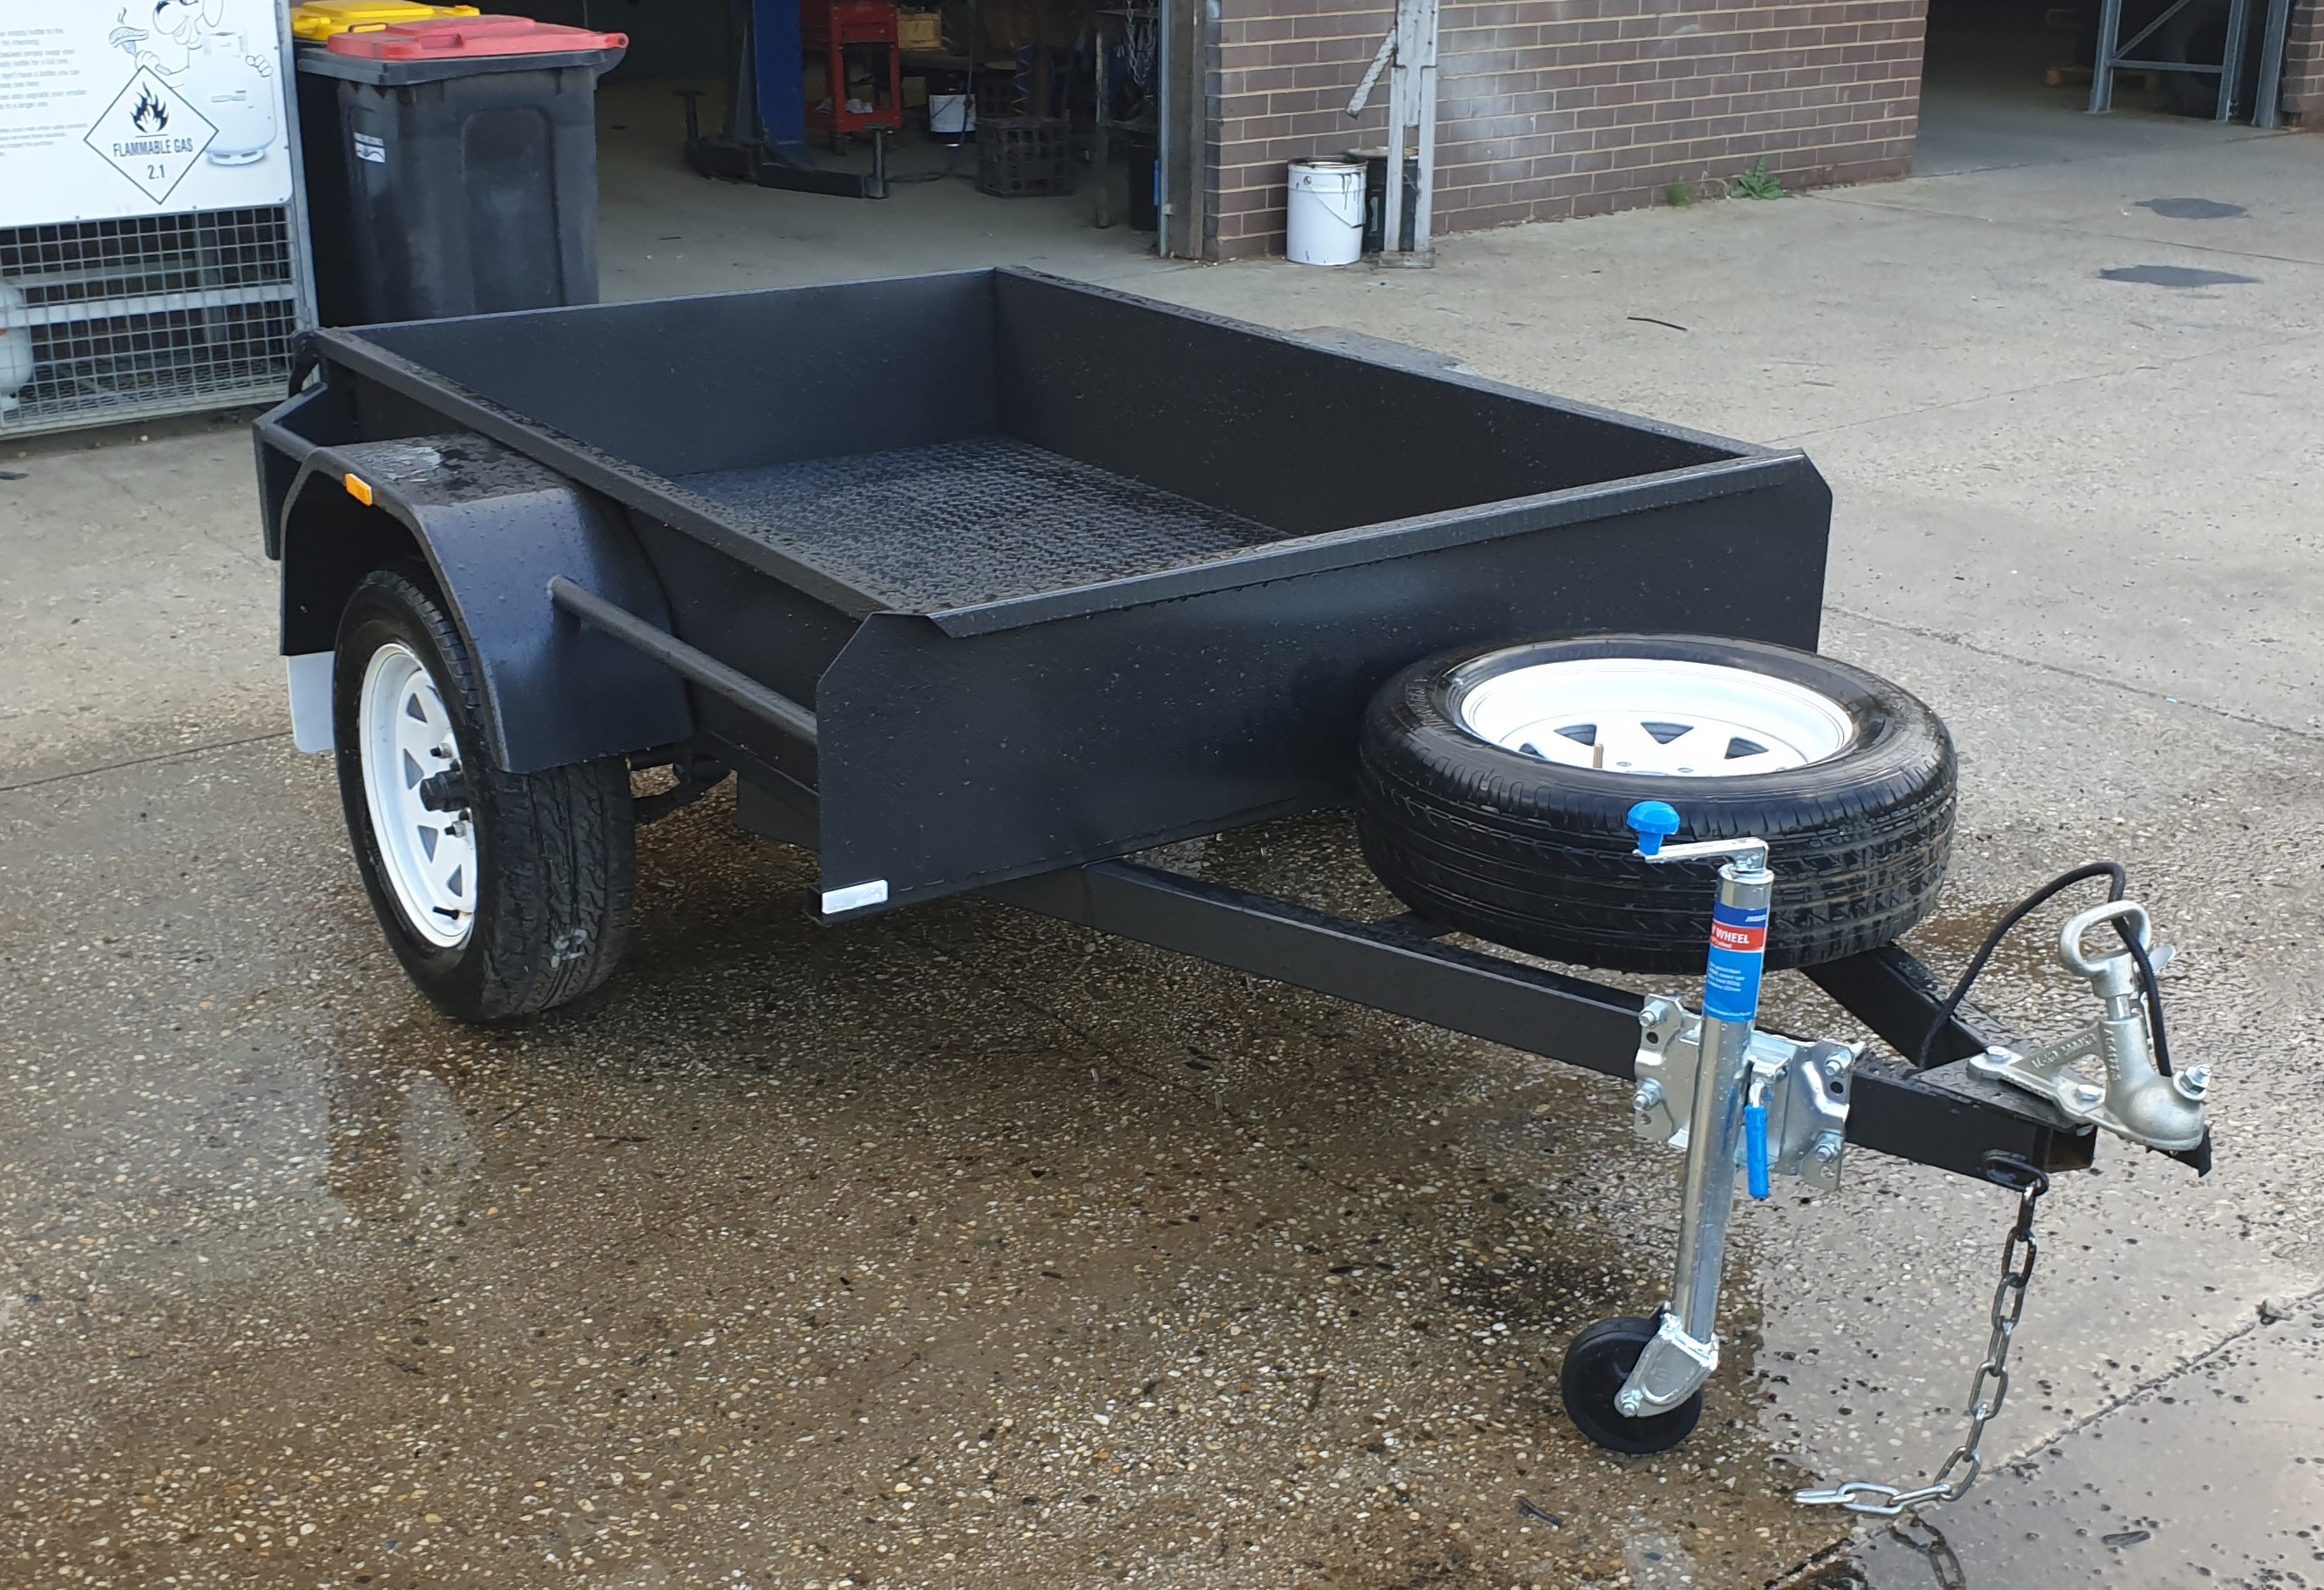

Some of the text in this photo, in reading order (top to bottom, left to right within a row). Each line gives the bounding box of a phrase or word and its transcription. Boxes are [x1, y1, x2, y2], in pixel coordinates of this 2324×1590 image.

[112, 138, 193, 158] FLAMMABLE GAS
[147, 164, 166, 179] 2.1
[1716, 927, 1750, 944] WHEEL
